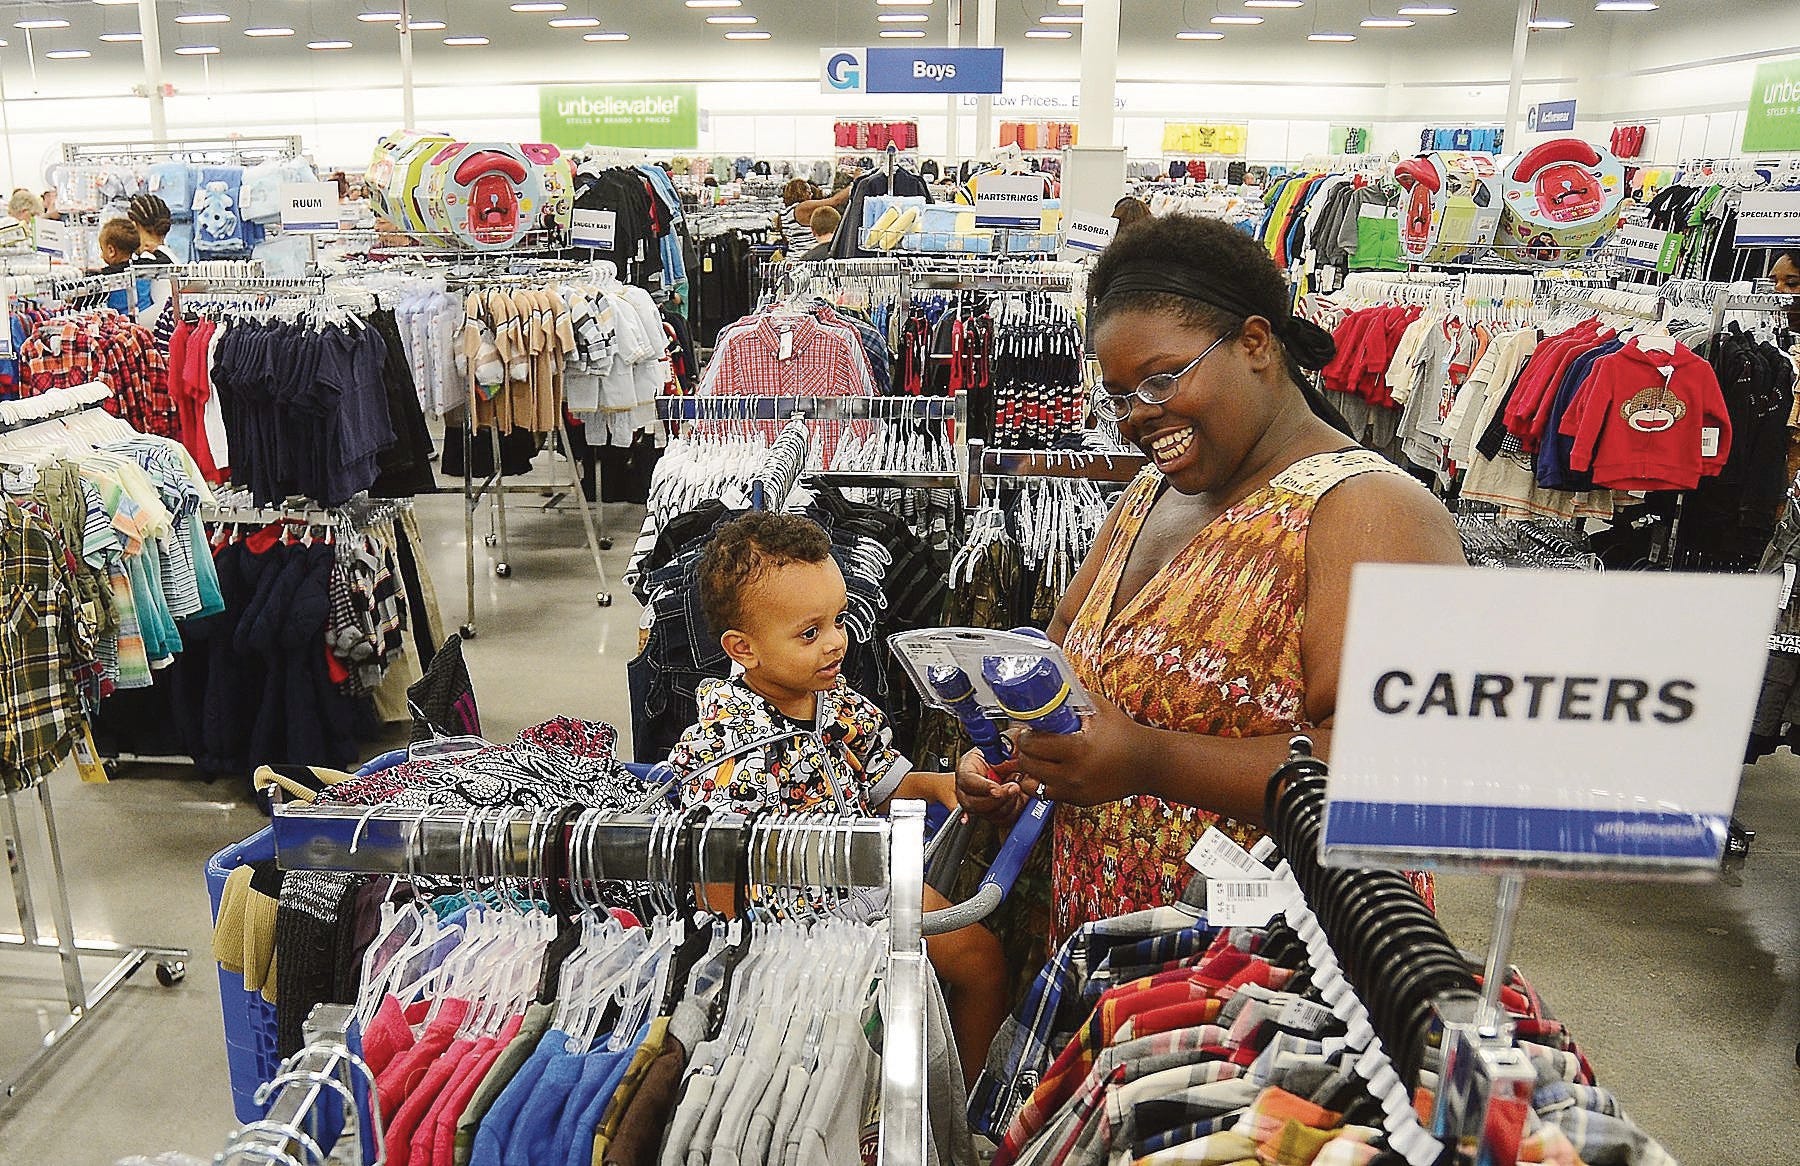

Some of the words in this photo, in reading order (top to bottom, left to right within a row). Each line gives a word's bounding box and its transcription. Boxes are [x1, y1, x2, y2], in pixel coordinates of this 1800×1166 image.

[913, 60, 956, 82] Boys
[558, 95, 680, 116] unbelievable!
[993, 96, 1016, 106] Low
[292, 199, 322, 208] RUUM
[977, 192, 1039, 202] HARTSTRINGS
[1071, 222, 1109, 236] ABSORBA
[1620, 237, 1637, 247] BON
[1638, 241, 1660, 251] BEBE
[1373, 671, 1697, 724] CARTERS
